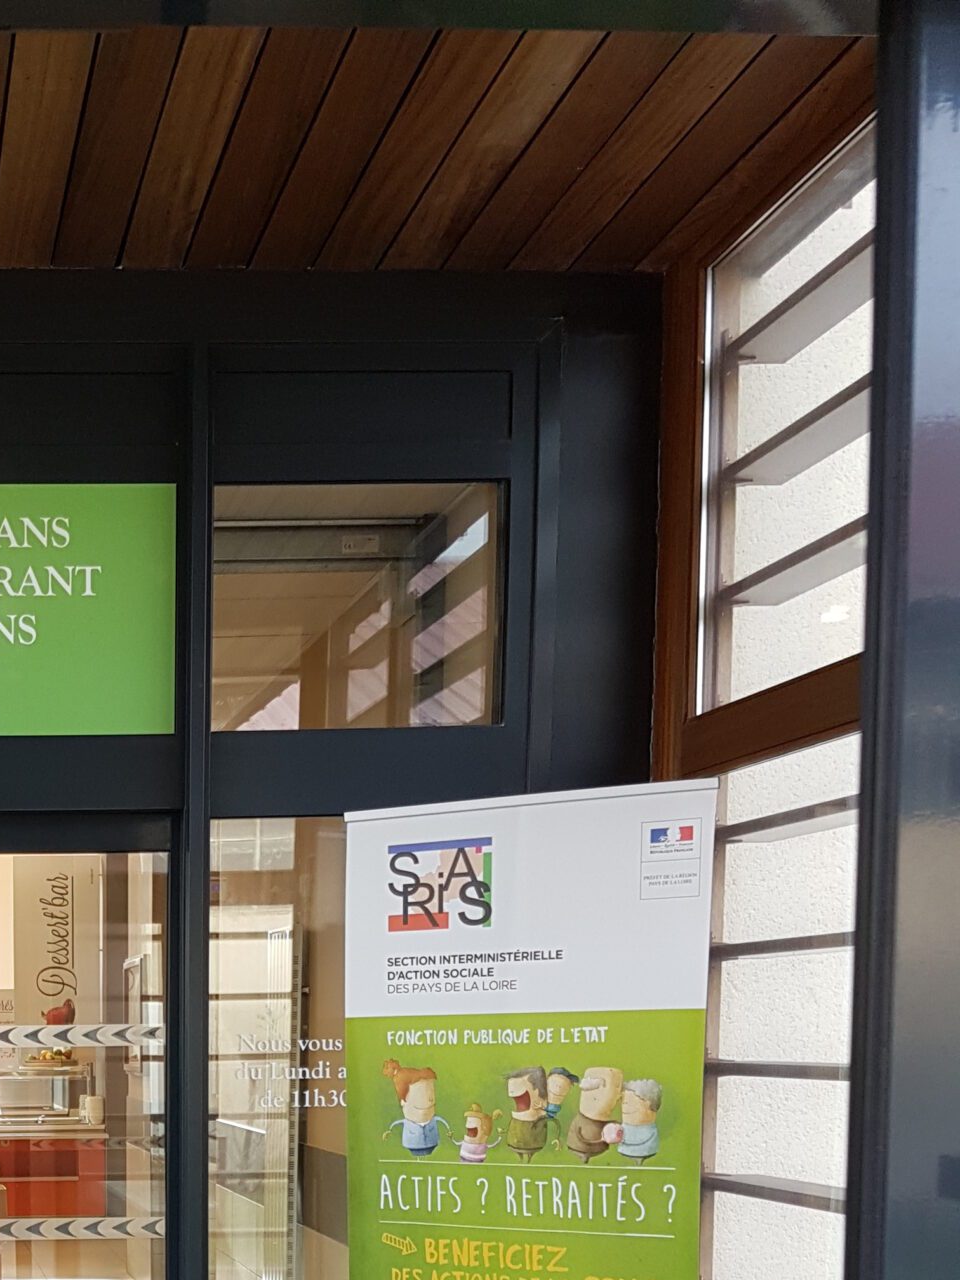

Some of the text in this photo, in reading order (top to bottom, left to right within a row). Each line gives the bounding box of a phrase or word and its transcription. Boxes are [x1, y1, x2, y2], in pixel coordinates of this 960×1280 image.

[36, 873, 78, 996] Dessert'bar
[387, 949, 563, 967] SECTION INTERMINISTÉRIELLE
[387, 967, 494, 981] D'ACTION SOCIALE
[387, 980, 517, 994] DES PAYS DE LA LOIRE
[236, 1033, 343, 1052] Nous vous
[387, 1026, 608, 1046] FONCTION PUBLIQUE DE L'ETAT
[235, 1062, 263, 1080] du
[271, 1061, 332, 1080] Lundi
[260, 1090, 284, 1109] de
[380, 1174, 676, 1224] ACTIFS ? RETRAITÉS ?
[425, 1237, 569, 1273] BENEFICIEZ
